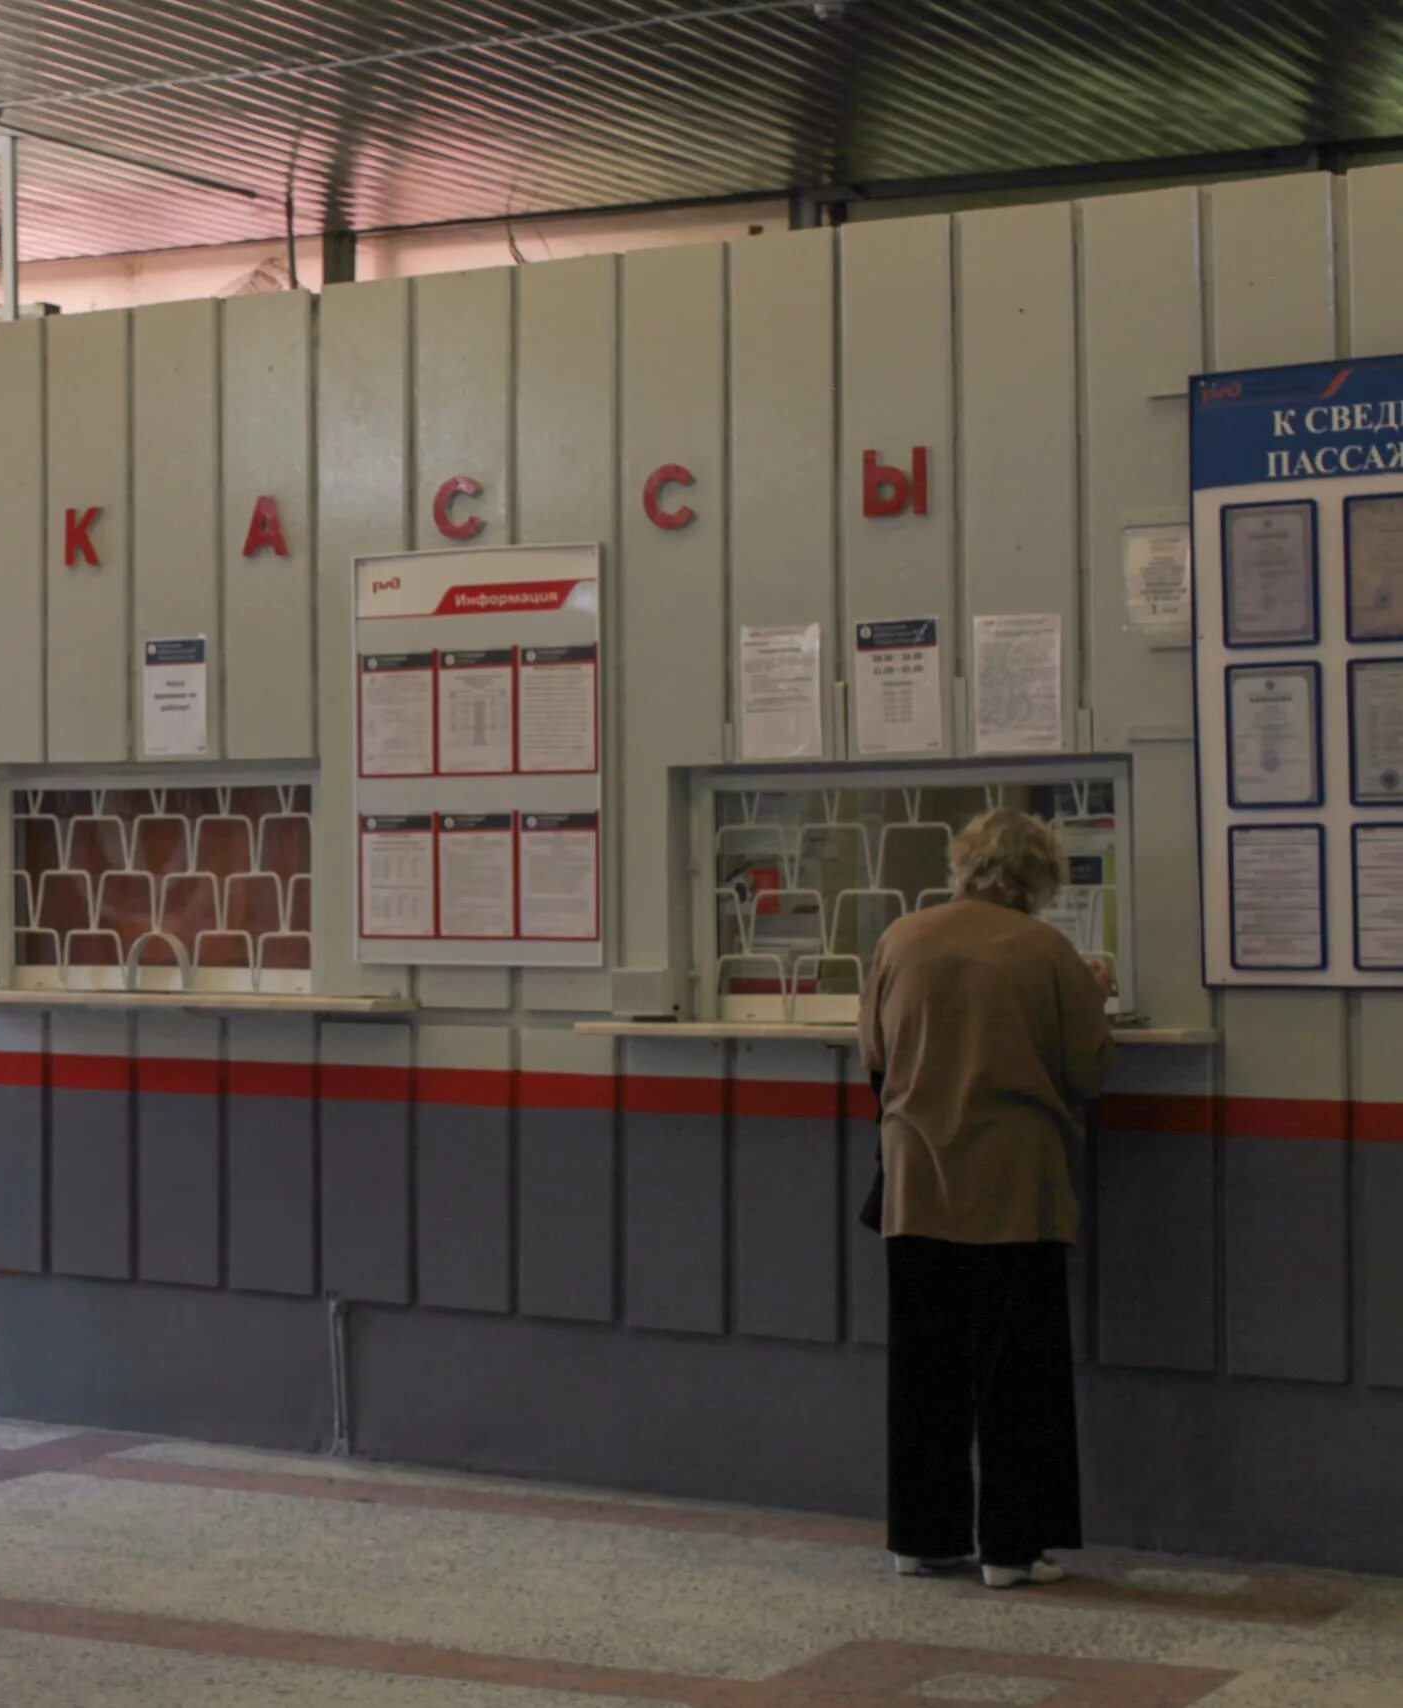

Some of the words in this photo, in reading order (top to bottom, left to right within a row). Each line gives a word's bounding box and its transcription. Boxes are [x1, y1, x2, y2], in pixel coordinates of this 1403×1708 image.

[1272, 408, 1296, 436] К
[1304, 400, 1403, 434] СВЕД
[455, 592, 558, 608] Информация
